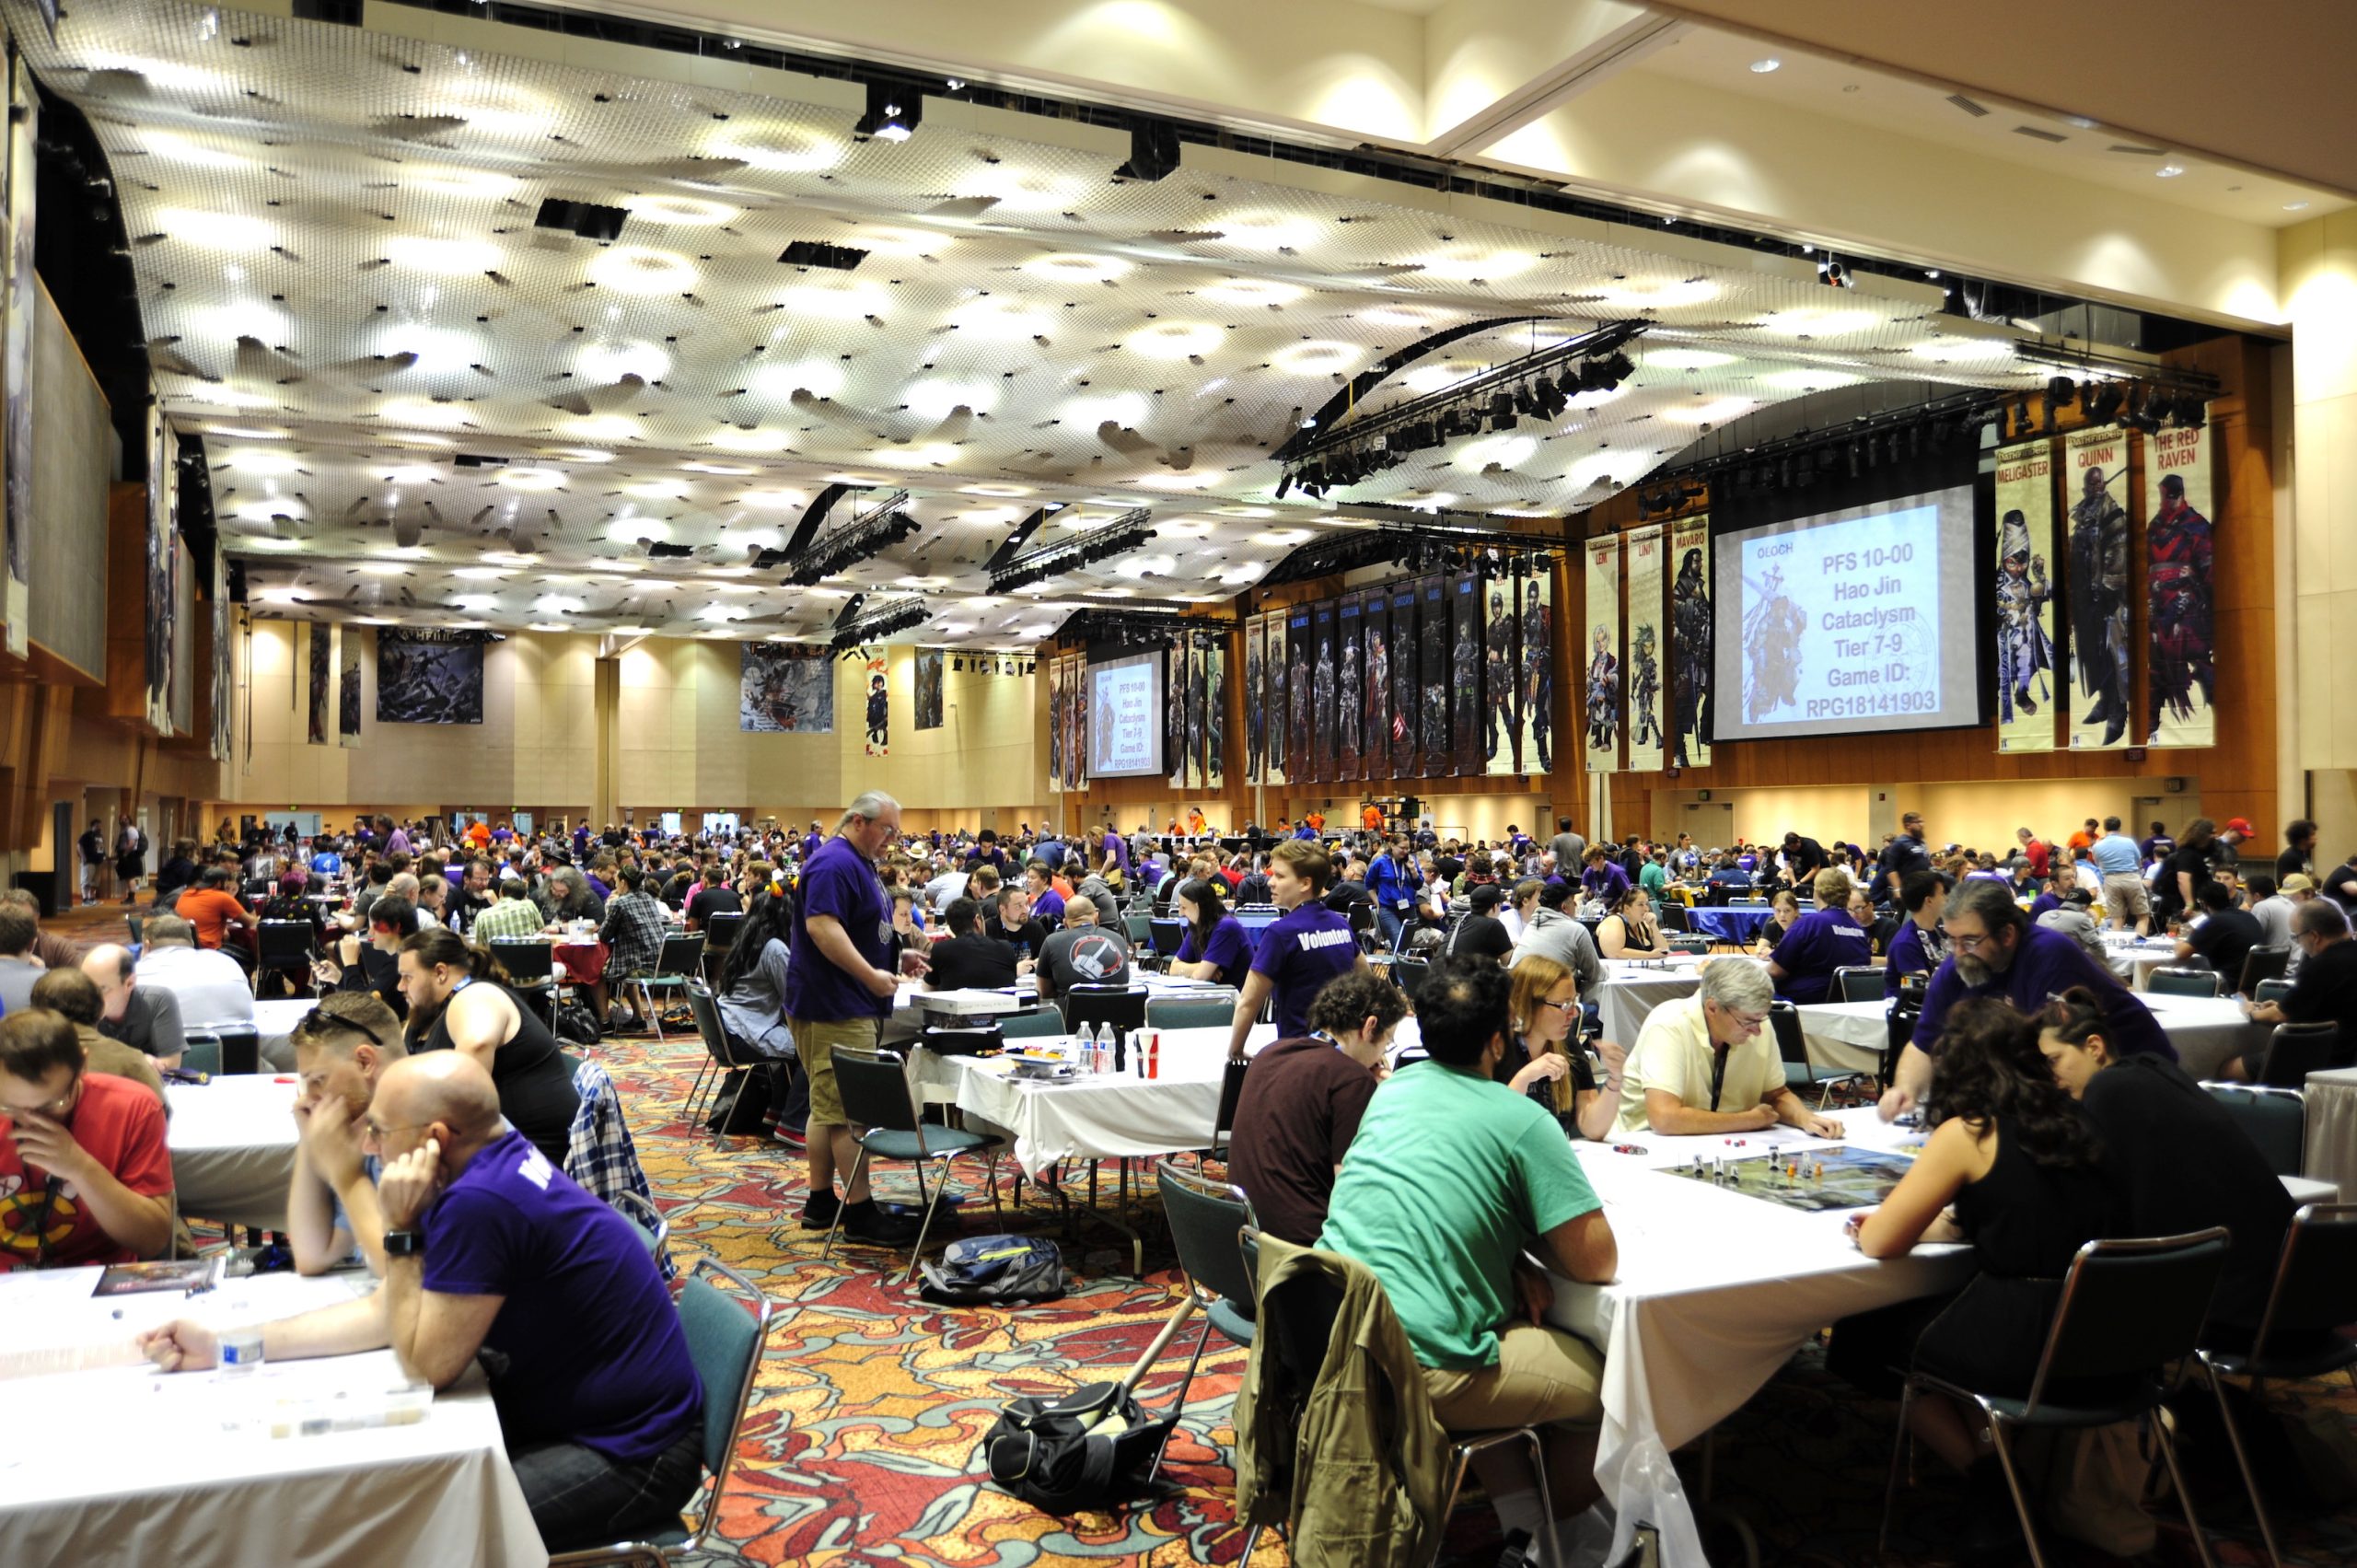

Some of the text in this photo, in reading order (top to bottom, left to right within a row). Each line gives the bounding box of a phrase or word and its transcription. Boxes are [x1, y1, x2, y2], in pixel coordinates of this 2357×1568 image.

[2154, 428, 2200, 453] THE RED
[2078, 447, 2114, 469] QUINN
[2158, 447, 2196, 470] RAVEN
[1997, 461, 2049, 485] MELIGASTER
[1676, 532, 1705, 549] MAVARO
[1757, 543, 1794, 559] OLOCH
[1822, 543, 1914, 575] PFS 10-00
[1834, 576, 1902, 601] Hao Jin
[1821, 606, 1916, 633] Cataclysm
[1834, 633, 1903, 659] Tier 7-9
[1828, 662, 1910, 688] Game ID:
[1806, 691, 1936, 718] RPG18141903
